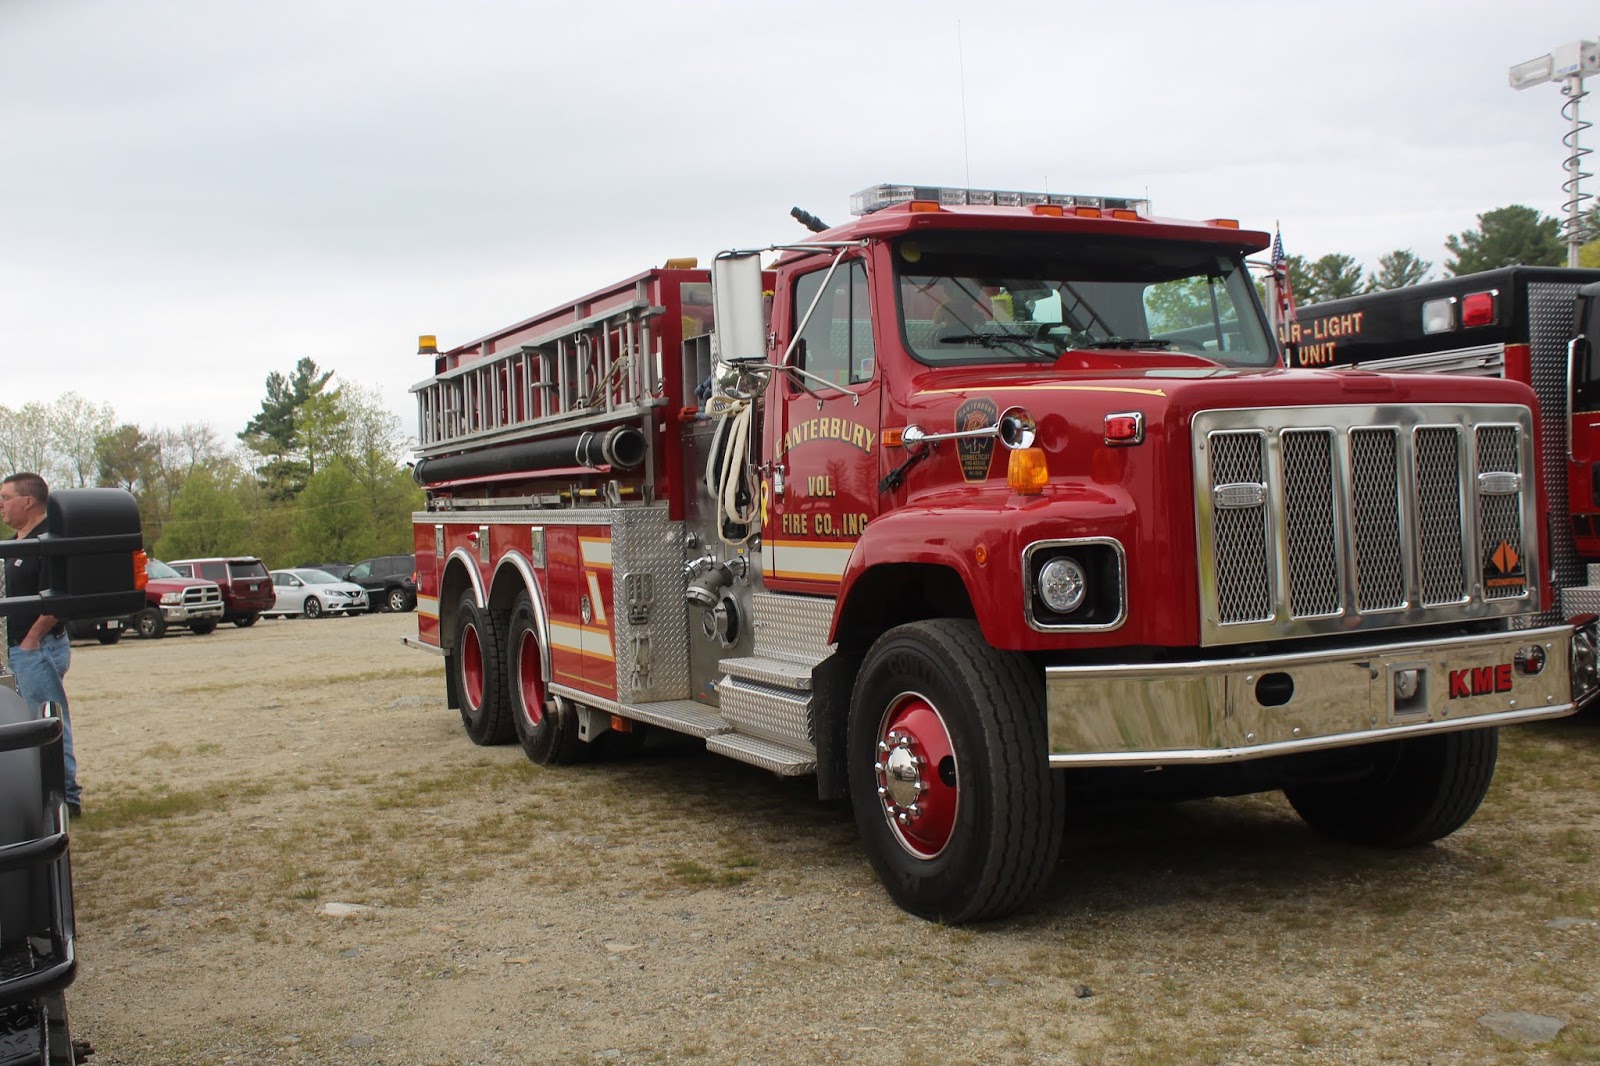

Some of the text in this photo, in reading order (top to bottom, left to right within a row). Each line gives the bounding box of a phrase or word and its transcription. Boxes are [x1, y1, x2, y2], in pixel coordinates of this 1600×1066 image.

[1279, 312, 1364, 345] AR-LIGHT
[1299, 341, 1337, 366] UNIT
[959, 403, 995, 417] CANTERBURY
[775, 417, 876, 459] CANTERBURY
[807, 475, 836, 497] VOL.
[782, 513, 808, 535] FIRE
[1448, 664, 1512, 699] KME
